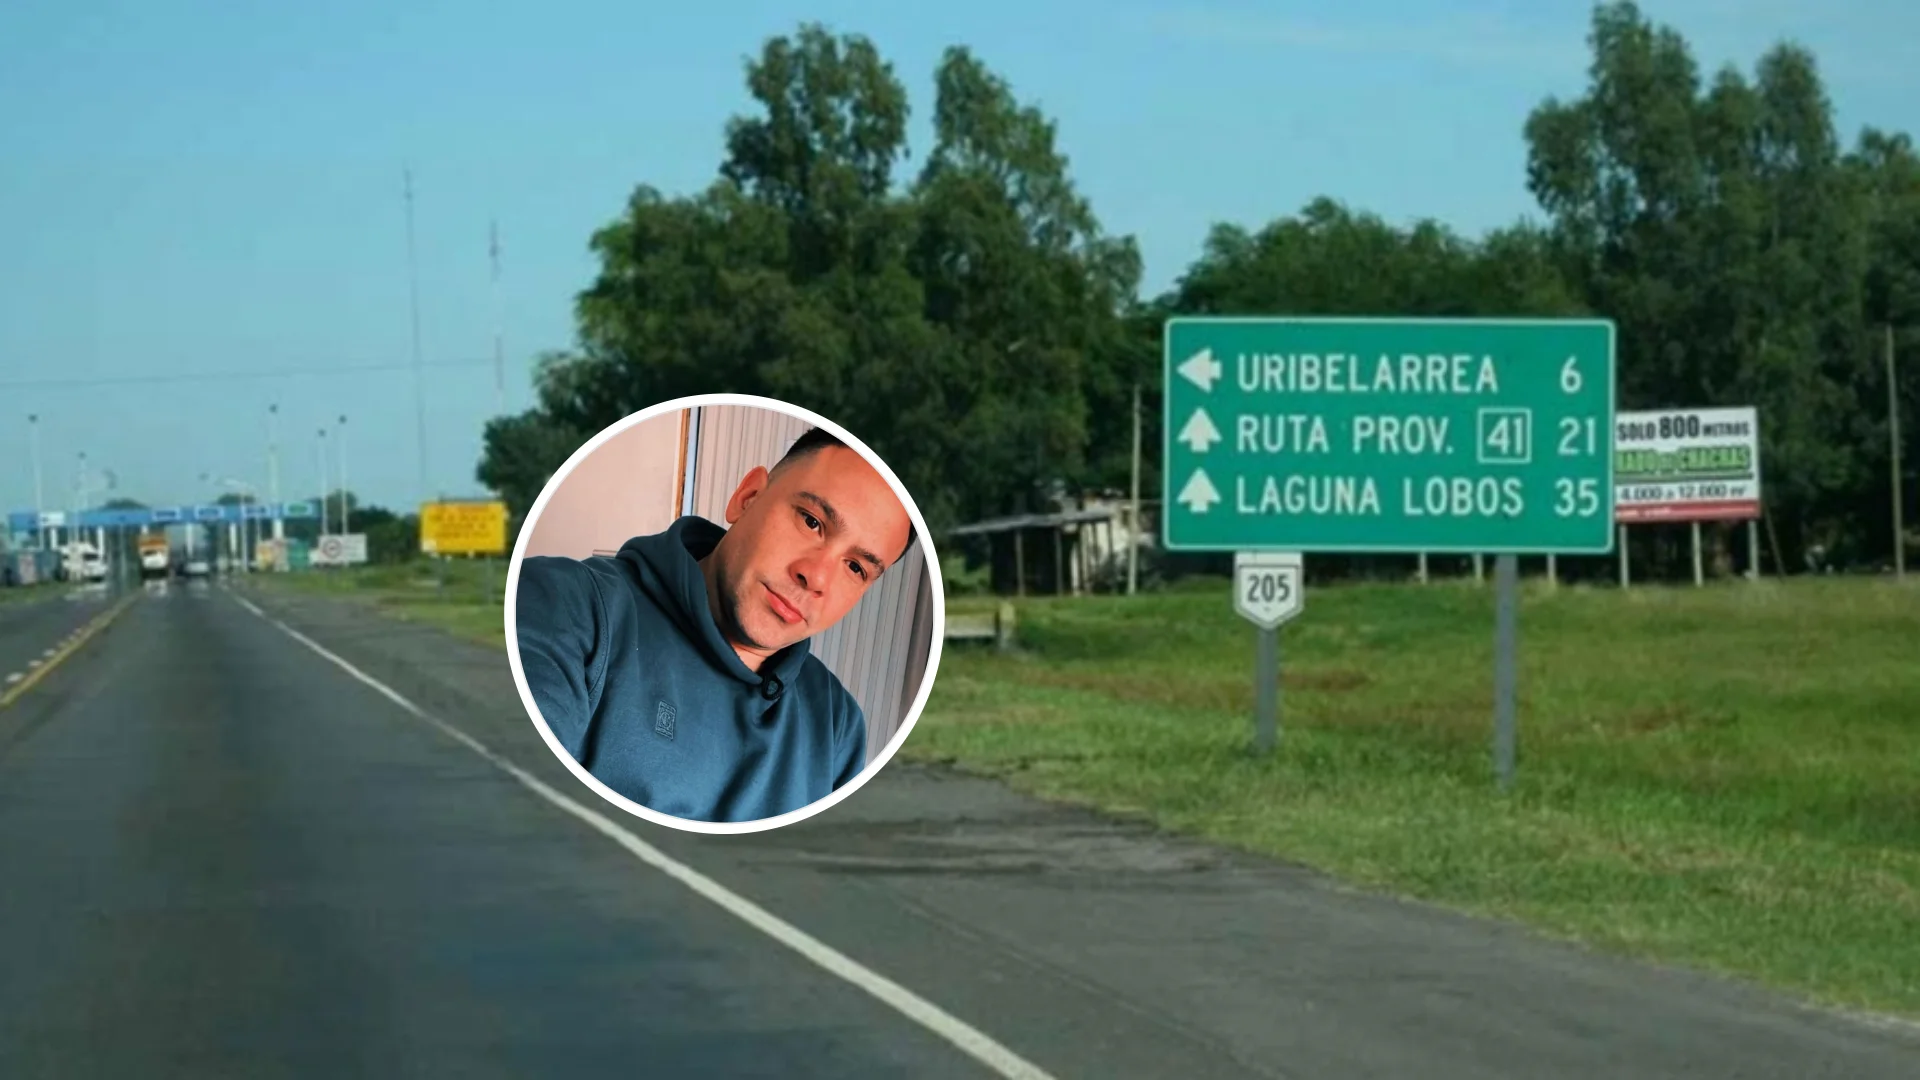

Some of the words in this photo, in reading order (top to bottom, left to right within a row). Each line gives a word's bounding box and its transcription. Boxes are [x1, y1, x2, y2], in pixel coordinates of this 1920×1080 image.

[1237, 354, 1498, 393] URIBELARREA
[1559, 357, 1583, 394] 6
[1237, 415, 1330, 453] RUTA
[1353, 416, 1454, 455] PROV.
[1486, 416, 1525, 455] 41
[1558, 417, 1597, 455] 21
[1618, 422, 1656, 441] SOLO
[1659, 414, 1700, 440] 800
[1237, 475, 1381, 514] LAGUNA
[1403, 477, 1524, 516] LOBOS
[1555, 478, 1599, 517] 35
[1247, 574, 1291, 602] 205
